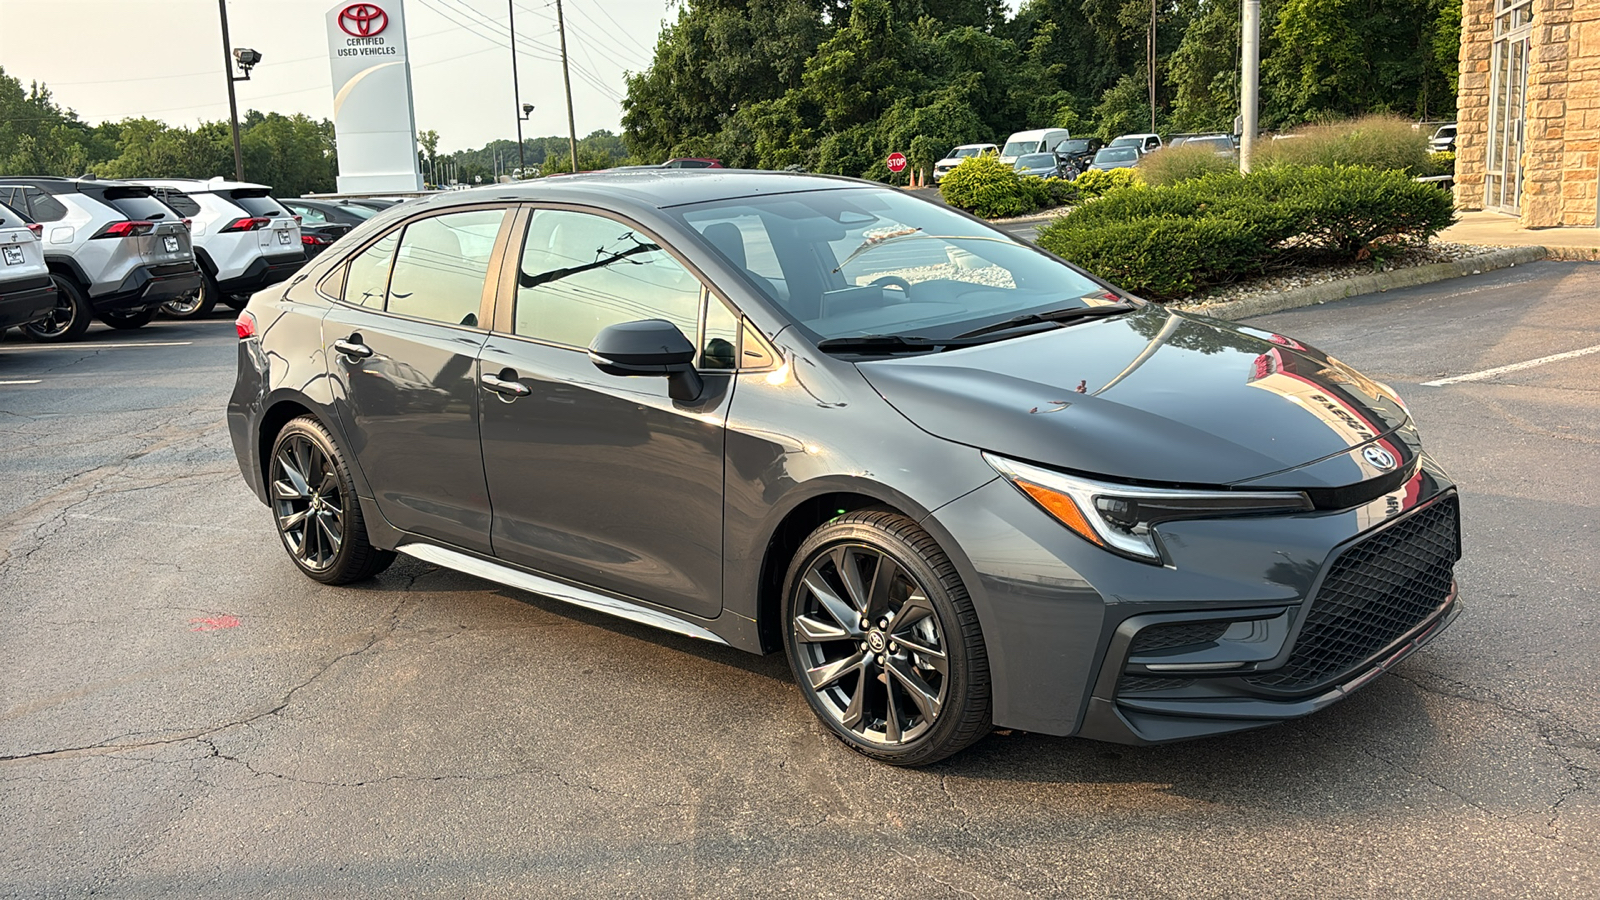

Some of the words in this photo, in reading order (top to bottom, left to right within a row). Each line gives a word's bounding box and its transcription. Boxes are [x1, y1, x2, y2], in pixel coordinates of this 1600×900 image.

[347, 37, 385, 46] CERTIFIED
[338, 48, 358, 57] USED
[360, 46, 396, 56] VEHICLES
[888, 158, 906, 167] STOP
